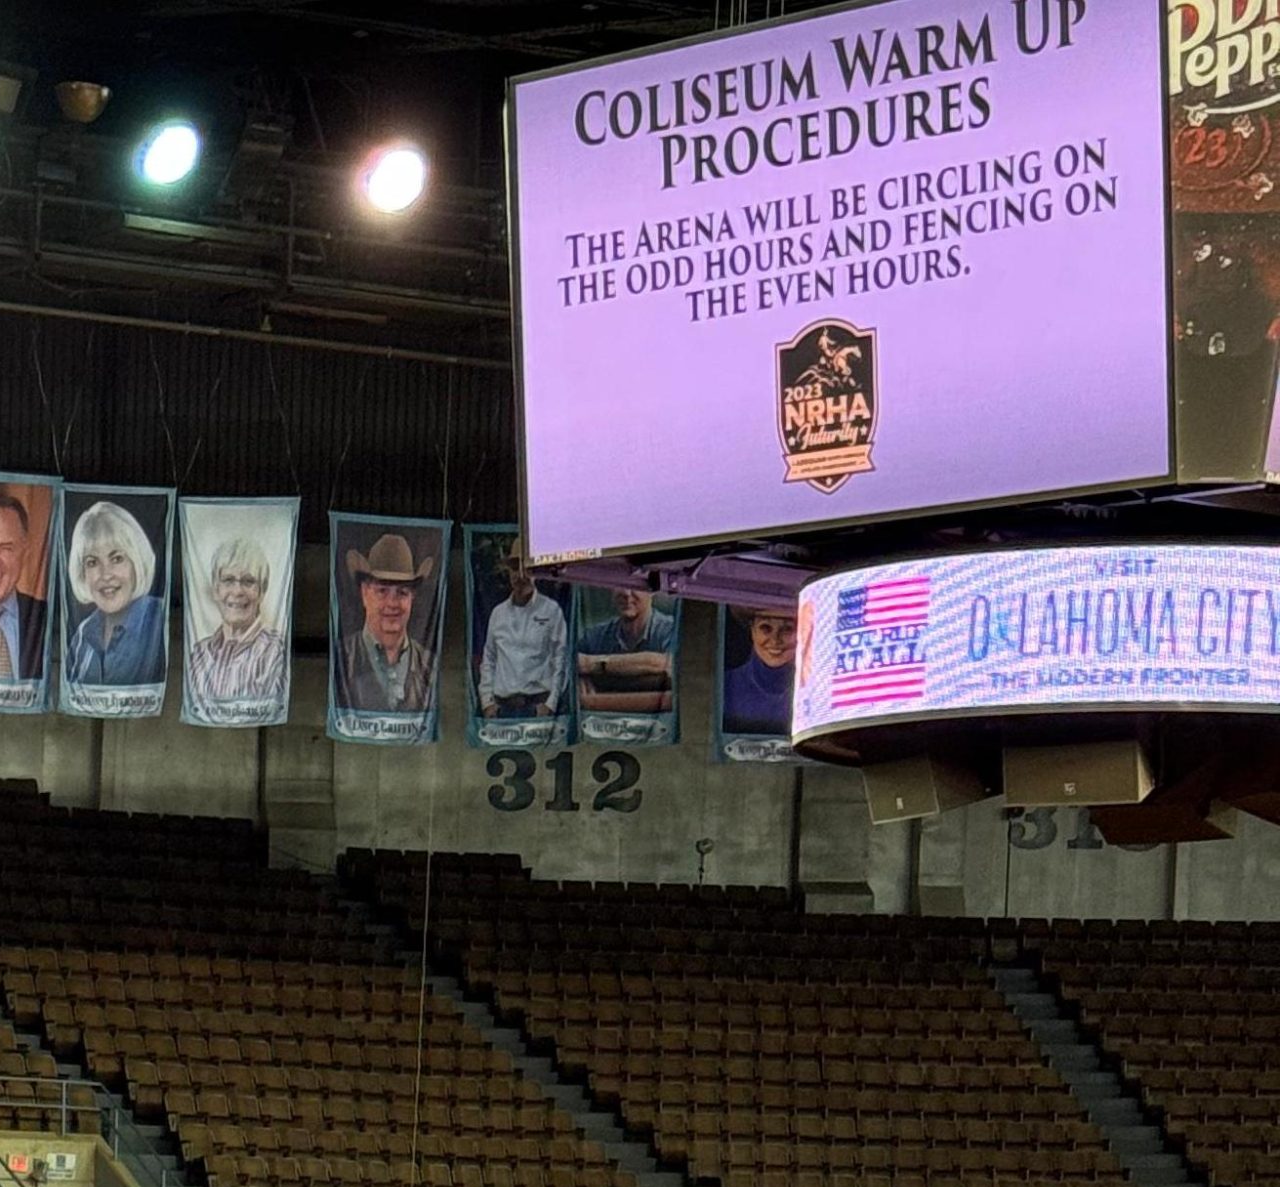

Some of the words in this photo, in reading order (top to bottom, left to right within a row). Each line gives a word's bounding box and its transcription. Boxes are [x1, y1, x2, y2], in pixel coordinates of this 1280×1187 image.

[575, 52, 820, 146] COLISEUM
[829, 14, 996, 92] WARM
[1010, 0, 1086, 55] UP
[661, 77, 990, 189] PROCEDURES
[558, 270, 617, 306] THE
[626, 256, 695, 294] ODD
[705, 232, 814, 281] HOURS
[822, 220, 892, 260] AND
[904, 189, 1053, 245] FENCING
[1065, 177, 1119, 216] ON
[566, 231, 626, 268] THE
[635, 213, 735, 255] ARENA
[744, 194, 821, 233] WILL
[831, 185, 867, 220] BE
[878, 152, 1041, 210] CIRCLING
[1054, 139, 1108, 179] ON
[686, 282, 748, 322] THE
[758, 267, 835, 310] EVEN
[848, 246, 971, 294] HOURS.
[784, 384, 823, 403] 2023
[785, 392, 871, 431] NRHA
[486, 749, 643, 813] 312
